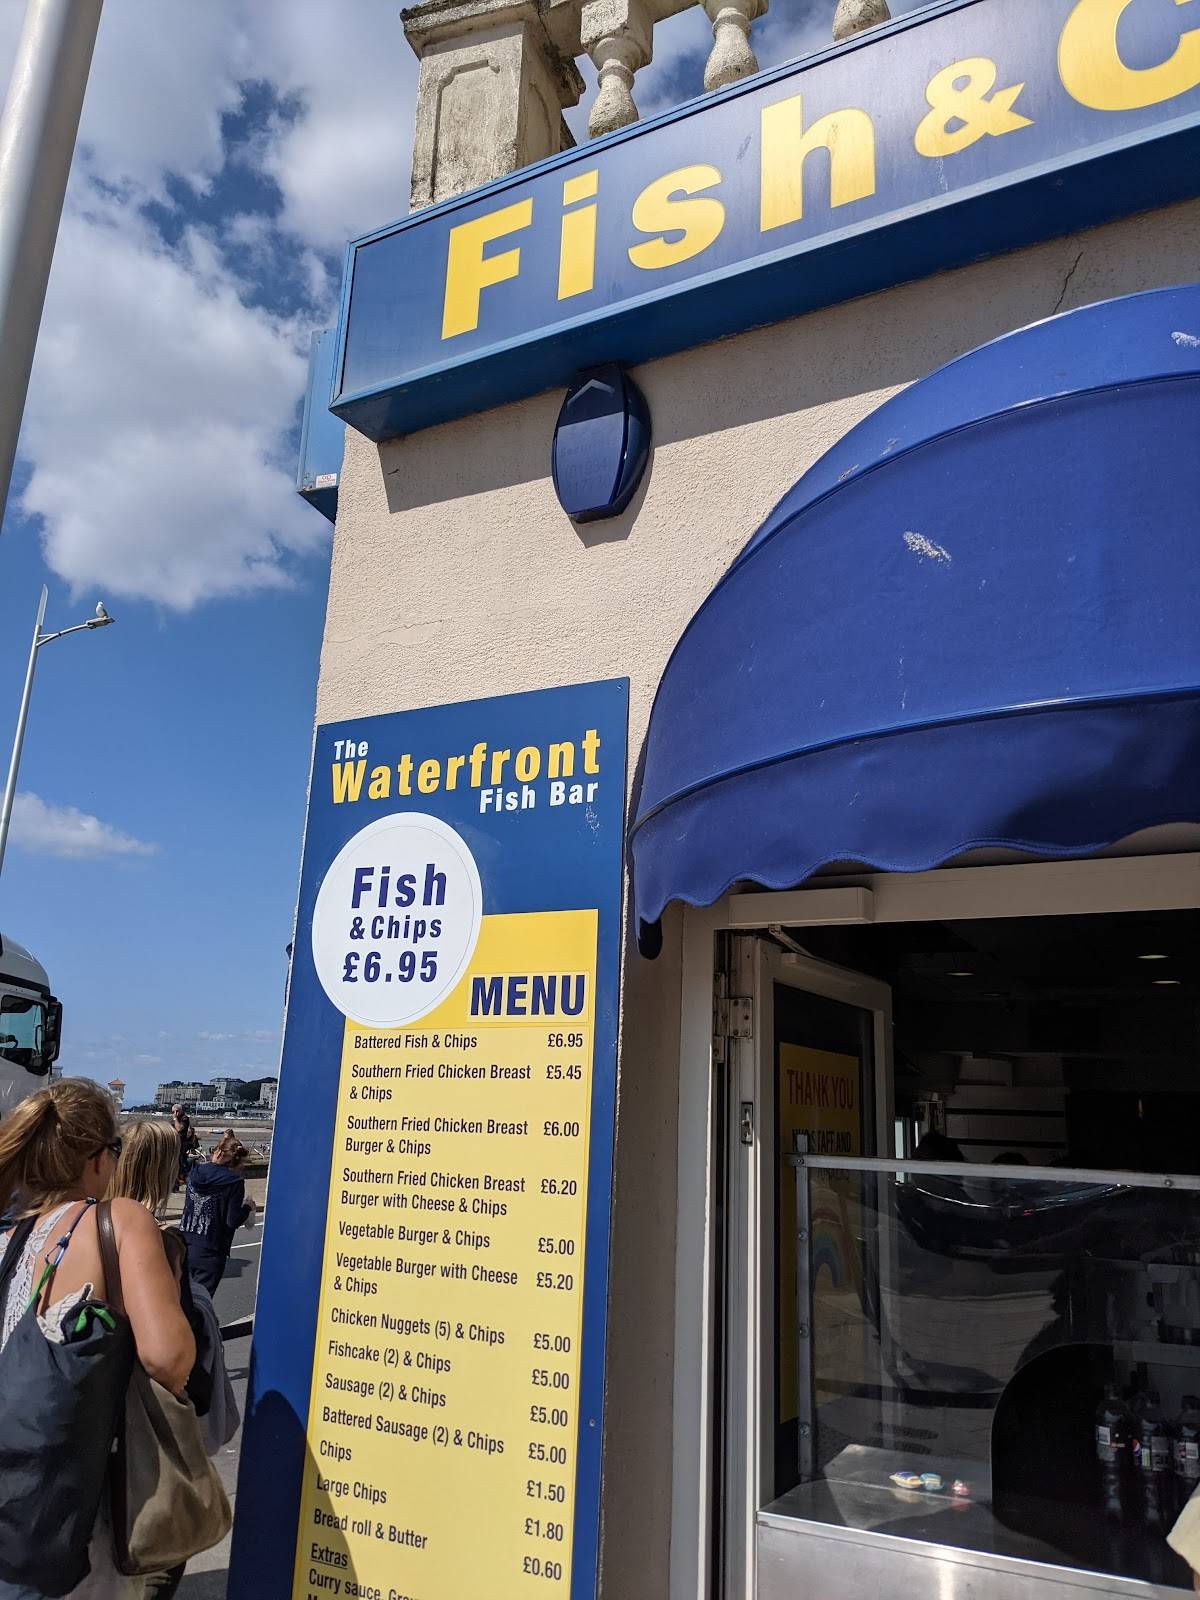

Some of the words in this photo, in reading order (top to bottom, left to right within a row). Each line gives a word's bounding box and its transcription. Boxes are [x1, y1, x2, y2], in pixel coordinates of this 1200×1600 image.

[441, 94, 877, 340] Fish
[914, 57, 1034, 157] &
[331, 728, 600, 804] Waterfront
[333, 739, 368, 760] The
[479, 786, 535, 813] Fish
[549, 780, 598, 806] Bar
[351, 863, 447, 908] Fish
[349, 916, 364, 939] &
[371, 914, 441, 943] Chips
[342, 950, 438, 982] £6.95
[470, 974, 585, 1016] MENU
[355, 1035, 401, 1048] Battered
[405, 1035, 427, 1048] Fish
[432, 1035, 440, 1048] &
[445, 1034, 477, 1050] Chips
[548, 1033, 582, 1047] £6.95
[352, 1065, 401, 1078] Southern
[406, 1064, 434, 1078] Fried
[438, 1064, 485, 1078] Chicken
[491, 1065, 531, 1079] Breast
[546, 1065, 581, 1079] £5.45
[350, 1086, 357, 1099] &
[362, 1086, 392, 1102] Chips
[786, 1069, 829, 1106] THANK
[831, 1074, 854, 1110] YOU
[348, 1116, 397, 1130] Southern
[402, 1117, 430, 1131] Fried
[435, 1118, 482, 1133] Chicken
[487, 1119, 528, 1135] Breast
[544, 1121, 579, 1137] £6.00
[346, 1138, 383, 1155] Burger
[387, 1139, 394, 1152] &
[399, 1139, 431, 1157] Chips
[343, 1168, 393, 1184] Southern
[398, 1171, 426, 1186] Fried
[431, 1172, 479, 1189] Chicken
[484, 1175, 525, 1192] Breast
[541, 1179, 577, 1195] £6.20
[341, 1190, 379, 1208] Burger
[383, 1193, 407, 1208] with
[412, 1195, 454, 1211] Cheese
[459, 1198, 467, 1212] &
[473, 1199, 507, 1218] Chips
[339, 1221, 394, 1239] Vegetable
[399, 1226, 438, 1245] Burger
[442, 1230, 451, 1244] &
[456, 1230, 490, 1250] Chips
[538, 1238, 574, 1255] £5.00
[334, 1276, 342, 1290] &
[346, 1277, 377, 1296] Chips
[337, 1252, 391, 1271] Vegetable
[396, 1258, 436, 1278] Burger
[441, 1263, 467, 1279] with
[472, 1265, 517, 1284] Cheese
[537, 1272, 573, 1290] £5.20
[332, 1308, 376, 1327] Chicken
[381, 1314, 430, 1335] Nuggets
[435, 1320, 450, 1340] (5)
[456, 1323, 464, 1338] &
[469, 1325, 504, 1346] Chips
[534, 1333, 570, 1352] £5.00
[329, 1340, 379, 1361] Fishcake
[384, 1348, 398, 1368] (2)
[404, 1351, 412, 1366] &
[417, 1352, 450, 1374] Chips
[532, 1369, 569, 1389] £5.00
[326, 1373, 374, 1397] Sausage
[379, 1382, 394, 1402] (2)
[399, 1385, 407, 1400] &
[412, 1387, 446, 1408] Chips
[530, 1406, 568, 1426] £5.00
[323, 1407, 372, 1429] Battered
[376, 1416, 428, 1441] Sausage
[433, 1426, 448, 1447] (2)
[453, 1429, 462, 1446] &
[468, 1432, 503, 1455] Chips
[529, 1443, 566, 1464] £5.00
[320, 1440, 351, 1462] Chips
[527, 1480, 564, 1502] £1.50
[317, 1474, 349, 1497] Large
[354, 1482, 386, 1504] Chips
[525, 1518, 563, 1541] £1.80
[311, 1543, 347, 1569] Extras
[314, 1509, 347, 1531] Bread
[352, 1520, 371, 1536] roll
[375, 1523, 384, 1539] &
[389, 1525, 427, 1548] Butter
[523, 1556, 561, 1580] £0.60
[309, 1568, 341, 1594] Curry
